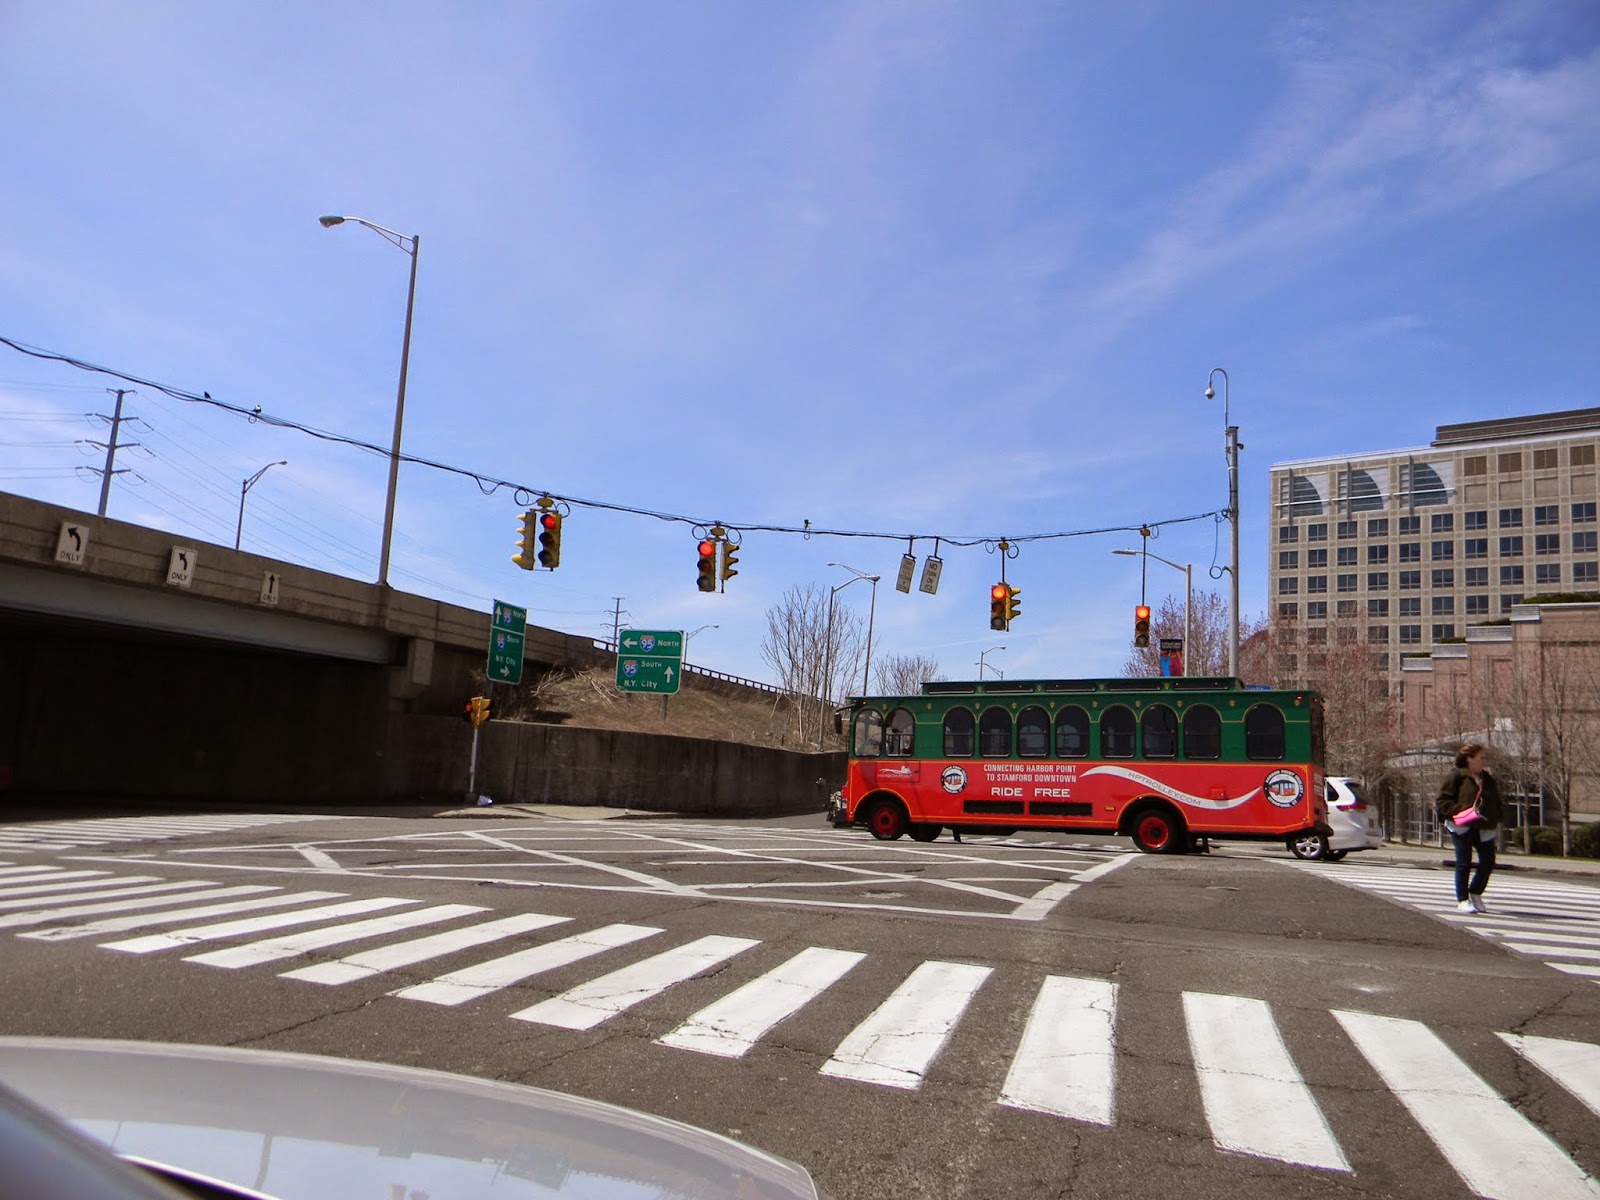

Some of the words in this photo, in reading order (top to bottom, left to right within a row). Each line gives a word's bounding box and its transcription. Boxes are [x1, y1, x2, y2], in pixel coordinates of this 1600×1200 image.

[60, 551, 82, 562] ONLY
[929, 563, 938, 571] NO
[171, 572, 189, 581] ONLY
[641, 639, 653, 649] 95
[624, 664, 636, 674] 95
[641, 660, 662, 668] SOUTH
[983, 764, 1024, 772] CONNECTING
[1026, 764, 1054, 773] HARBOR
[1056, 765, 1077, 773] POINT
[986, 773, 995, 782] TO
[997, 774, 1033, 782] STAMFORD
[1034, 774, 1077, 783] DOWNTOWN
[991, 787, 1023, 796] RIDE
[1034, 788, 1071, 798] FREE
[1127, 771, 1202, 806] HPTROLLEY.COM
